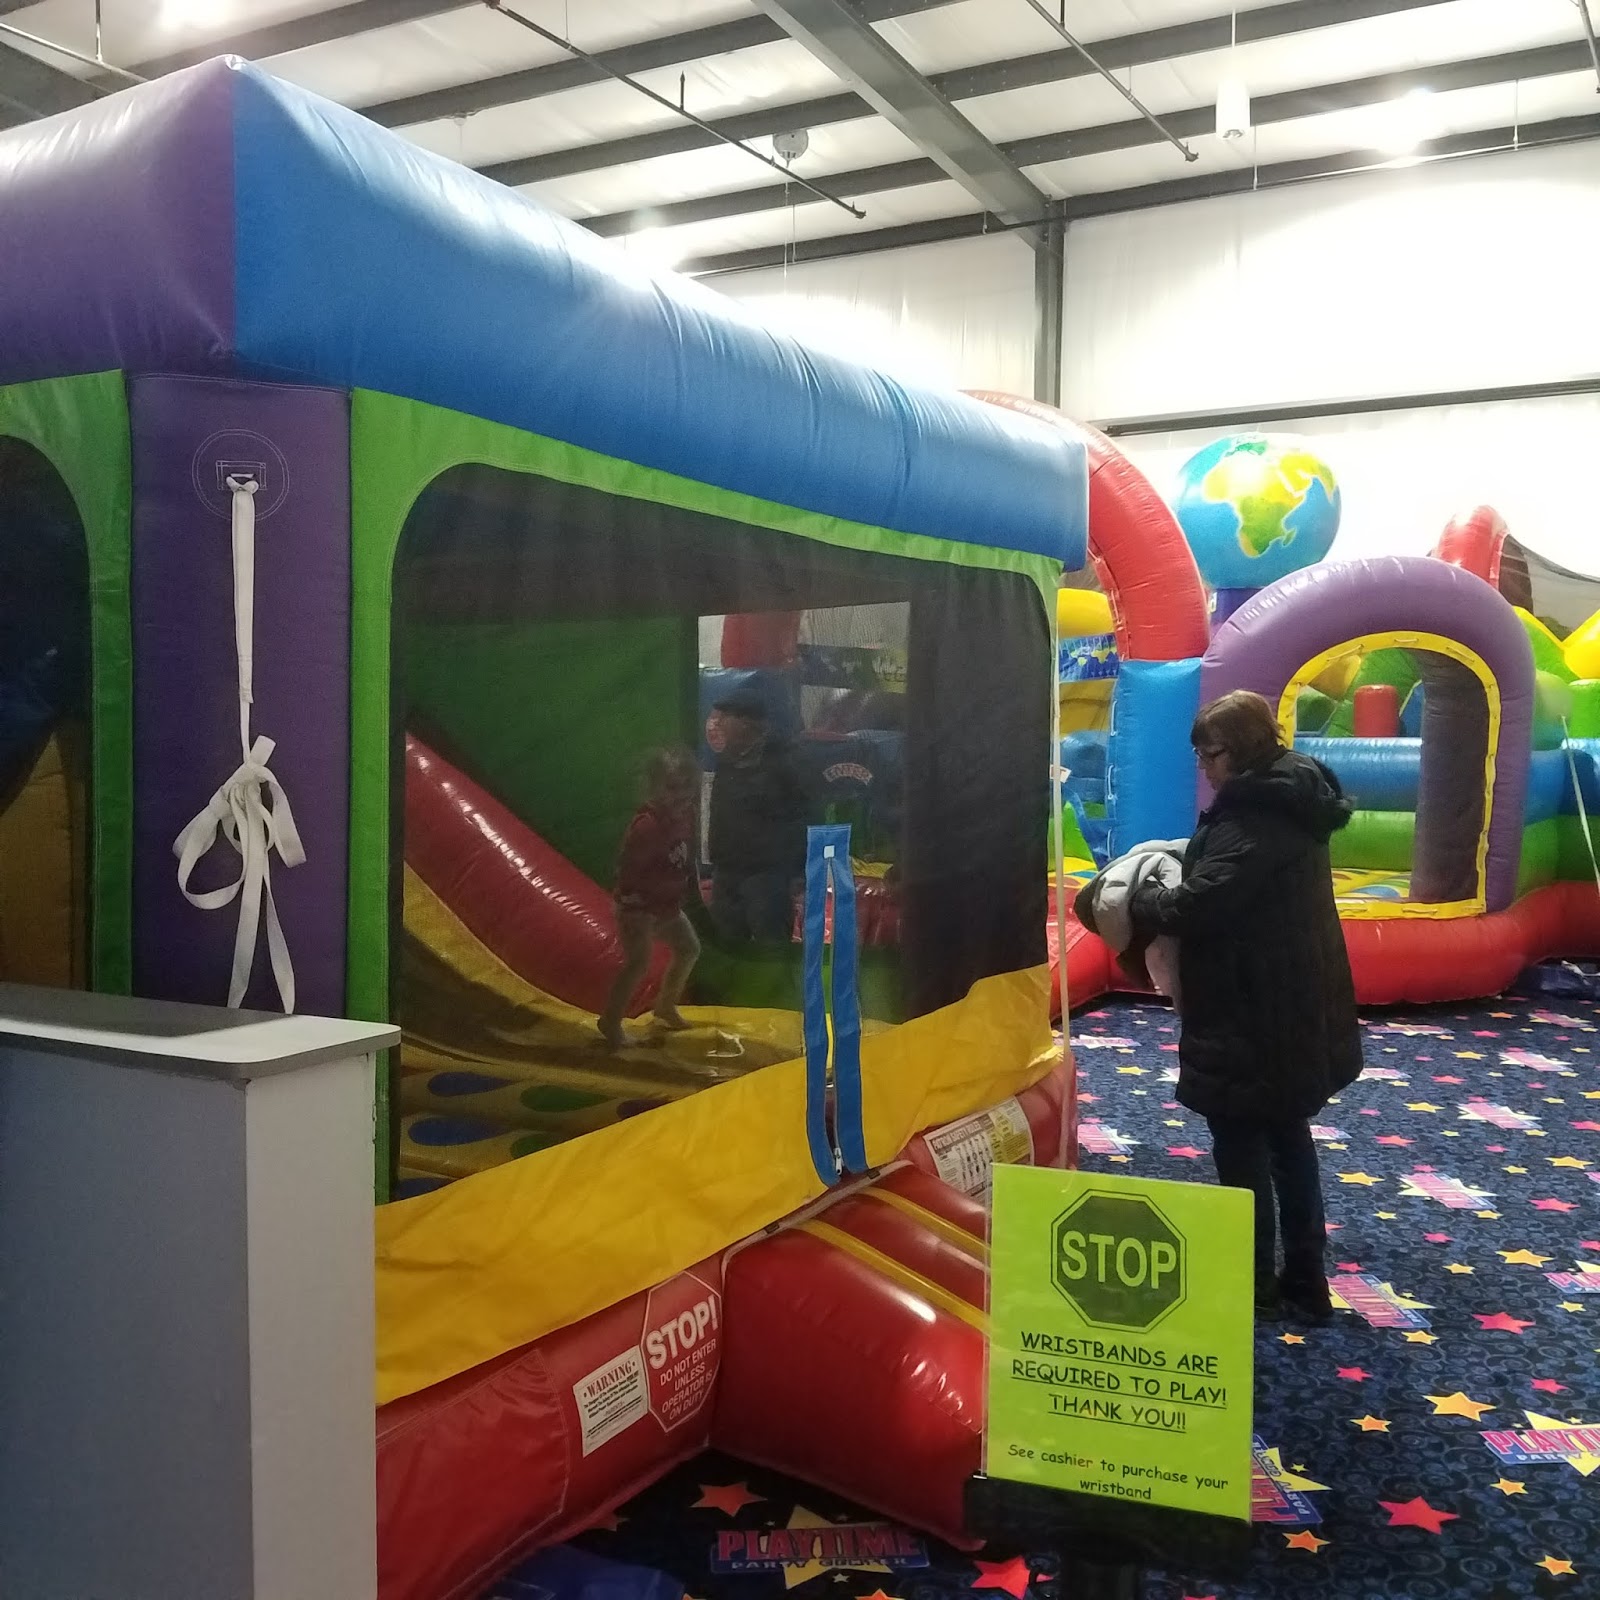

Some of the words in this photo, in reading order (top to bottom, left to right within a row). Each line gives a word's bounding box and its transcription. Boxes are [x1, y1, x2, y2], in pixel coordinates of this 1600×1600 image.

[1061, 1230, 1177, 1289] STOP
[647, 1295, 718, 1369] STOP!
[1021, 1331, 1167, 1367] WRISTBANDS
[1176, 1353, 1219, 1375] ARE
[586, 1360, 633, 1399] WARNING
[660, 1368, 673, 1386] DO
[674, 1355, 691, 1377] NOT
[692, 1338, 717, 1364] ENTER
[674, 1361, 706, 1391] UNLESS
[1012, 1358, 1121, 1391] REQUIRED
[1130, 1375, 1161, 1396] TO
[1169, 1381, 1227, 1406] PLAY!
[661, 1375, 705, 1414] OPERATOR
[705, 1369, 713, 1383] IS
[669, 1404, 681, 1420] ON
[683, 1388, 705, 1411] DUTY
[1049, 1393, 1123, 1421] THANK
[1131, 1404, 1187, 1430] YOU!!
[1008, 1444, 1035, 1460] See
[1041, 1448, 1094, 1469] cashier
[1100, 1459, 1116, 1473] to
[1122, 1462, 1189, 1485] purchase
[1195, 1475, 1229, 1491] your
[1080, 1479, 1152, 1500] wristband
[718, 1526, 921, 1561] PLAYTIME
